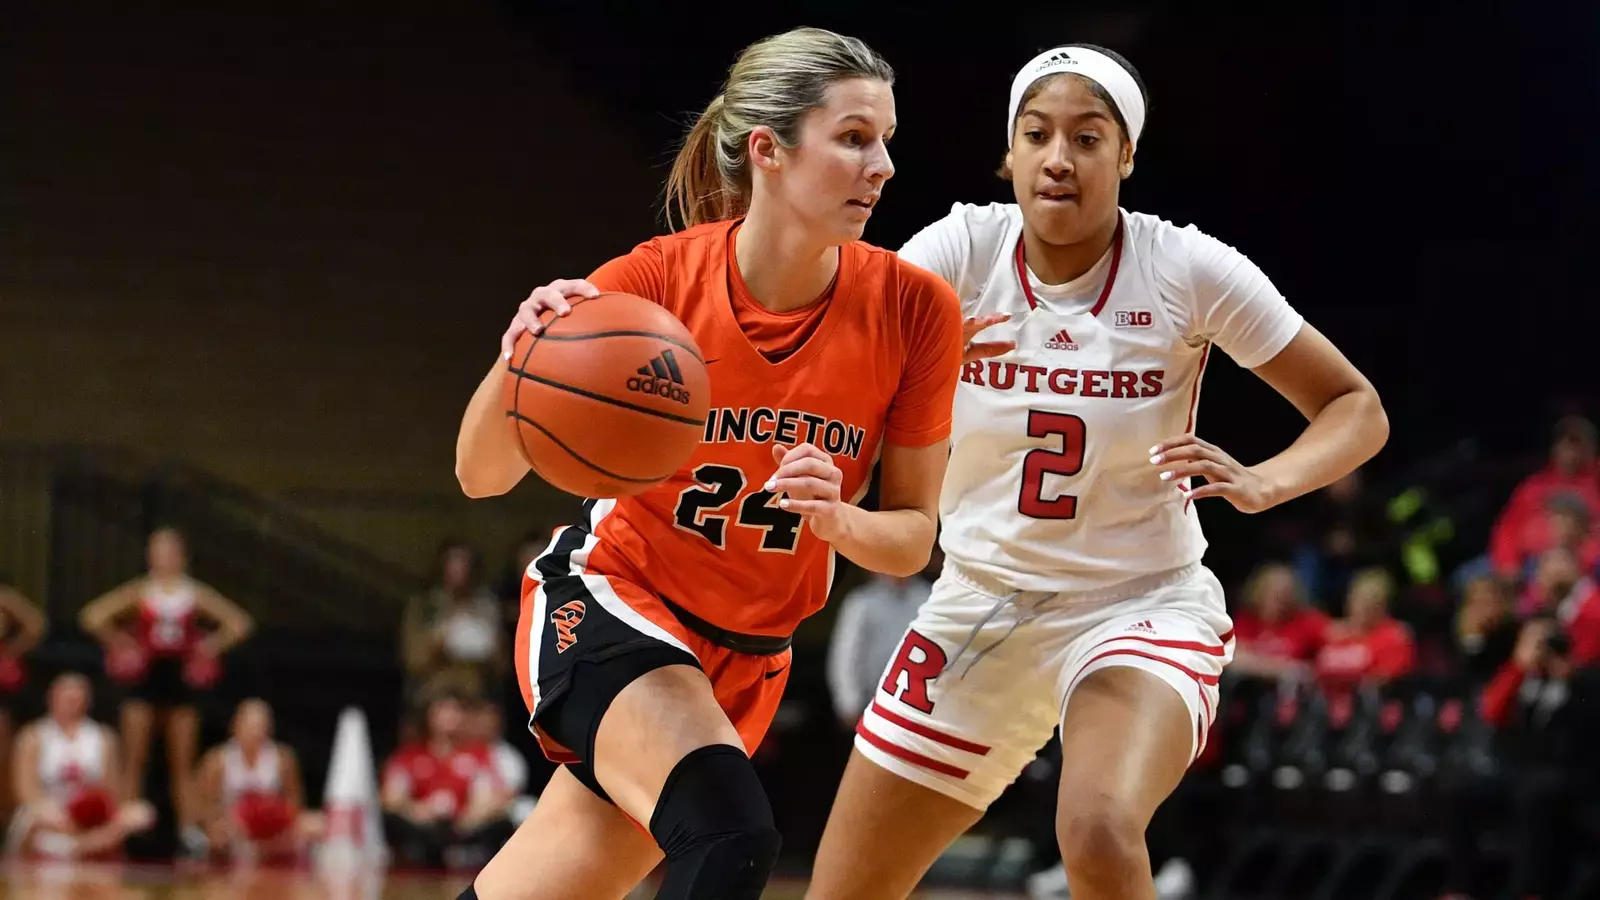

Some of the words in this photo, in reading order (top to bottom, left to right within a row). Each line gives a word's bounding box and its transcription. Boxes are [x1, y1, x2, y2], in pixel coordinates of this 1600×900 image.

[1044, 341, 1079, 351] adidas
[626, 376, 690, 405] adidas
[961, 359, 1165, 398] RUTGERS
[700, 407, 866, 460] INCETON
[1018, 409, 1087, 520] 2
[672, 463, 804, 555] 24
[882, 628, 948, 715] R
